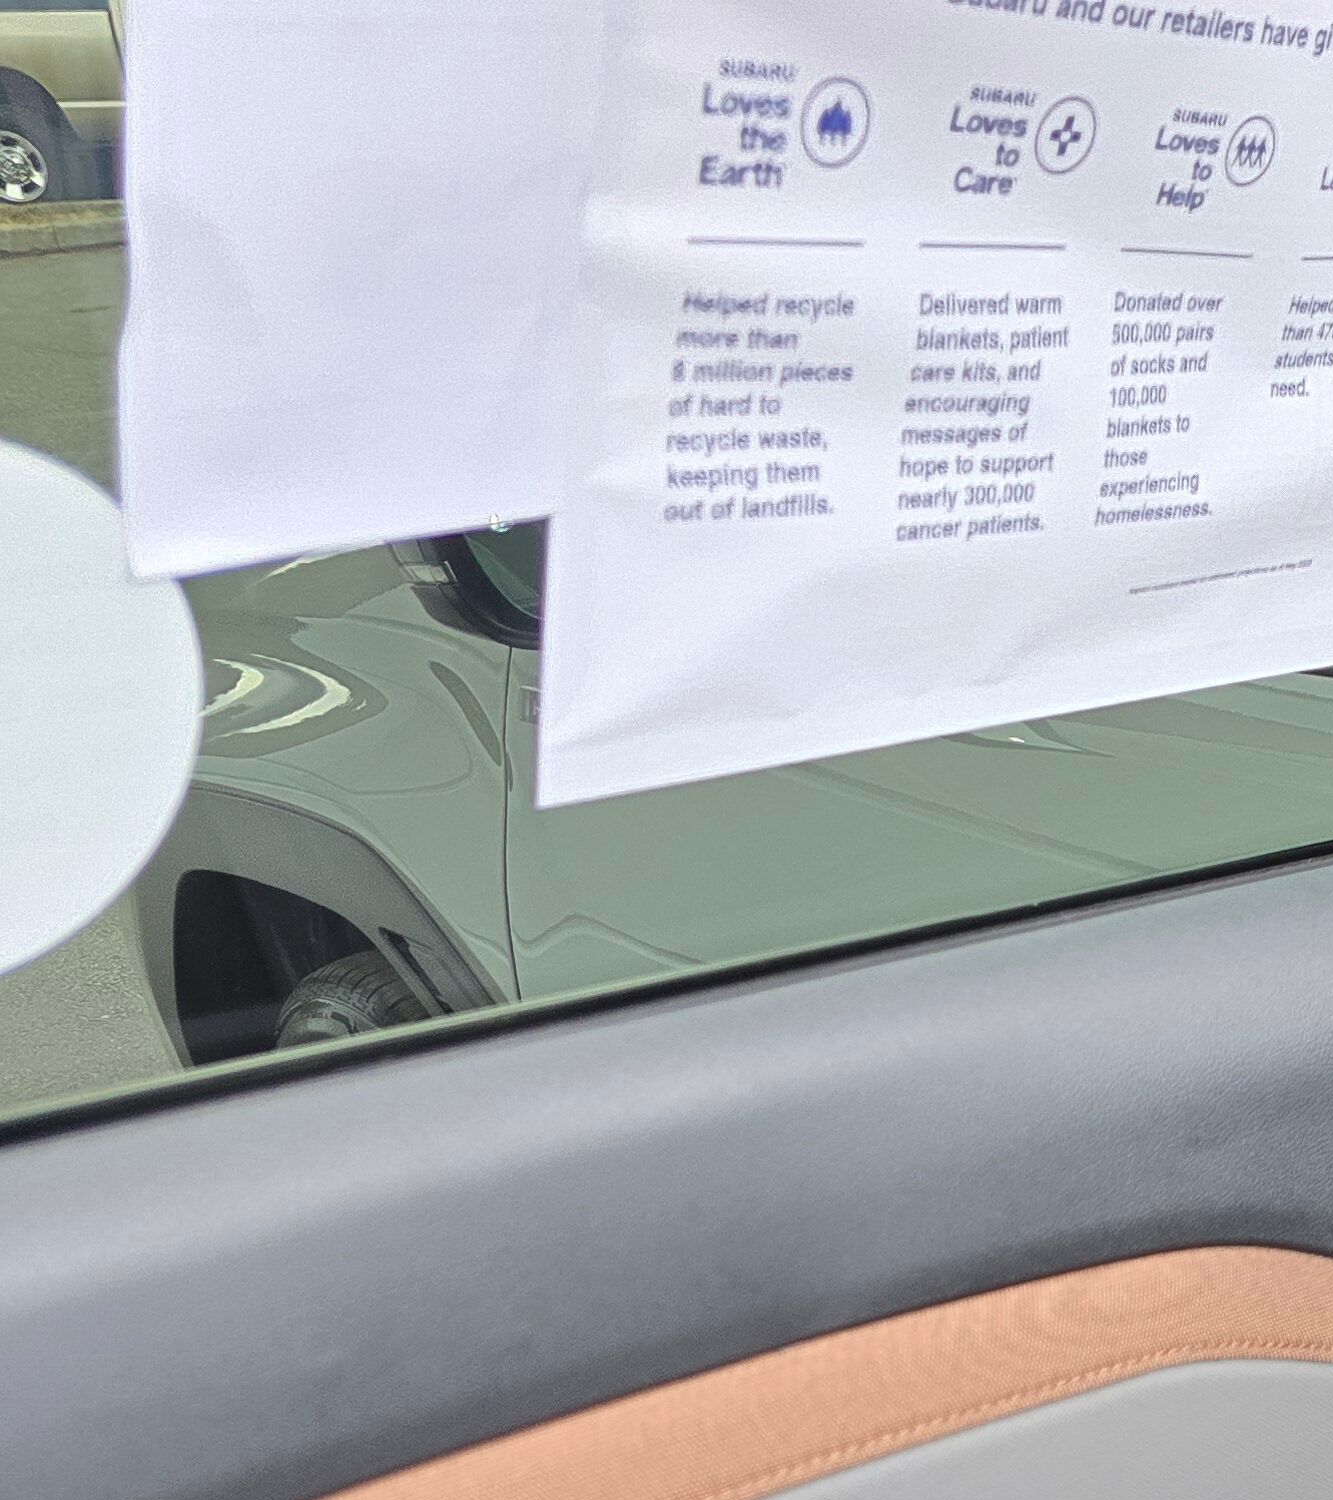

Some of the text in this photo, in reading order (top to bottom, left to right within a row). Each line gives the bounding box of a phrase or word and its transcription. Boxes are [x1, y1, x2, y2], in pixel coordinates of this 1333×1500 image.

[1112, 4, 1154, 30] our
[1160, 10, 1254, 42] retailers
[1260, 15, 1308, 49] have
[720, 58, 796, 82] SUBARU
[703, 82, 791, 117] Loves
[970, 87, 1036, 106] SUBARU
[949, 105, 1027, 137] Loves
[1172, 108, 1228, 127] SUBARU
[741, 126, 786, 151] the
[1154, 125, 1220, 155] Loves
[996, 142, 1020, 167] to
[700, 155, 782, 187] Earth
[953, 167, 1014, 194] Care
[1192, 160, 1212, 181] to
[1156, 183, 1206, 213] Help
[683, 293, 854, 323] Helped recycle
[919, 292, 1062, 316] Delivered warm
[1115, 291, 1224, 314] Donated over
[676, 329, 798, 349] more than
[916, 326, 1068, 353] blankets, patient
[1112, 322, 1214, 346] 500,000 pairs
[1282, 322, 1312, 341] than
[911, 360, 1041, 383] care kits, and
[1111, 352, 1208, 377] of socks and
[1275, 350, 1333, 370] students
[692, 360, 773, 382] million
[780, 362, 854, 387] pieces
[1109, 385, 1167, 409] 100,000
[1271, 378, 1309, 398] need.
[668, 394, 781, 416] of hard to
[905, 392, 1030, 416] encouraging
[902, 422, 1029, 448] messages of
[1107, 415, 1190, 439] blankets to
[666, 427, 827, 457] recycle waste,
[900, 452, 1054, 479] hope to support
[1104, 449, 1148, 468] those
[667, 462, 820, 490] keeping them
[1100, 473, 1199, 500] experiencing
[664, 493, 833, 521] out of landfills.
[898, 483, 1034, 511] nearly 300,000
[1095, 502, 1213, 526] homelessness.
[897, 516, 1044, 542] cancer patients.
